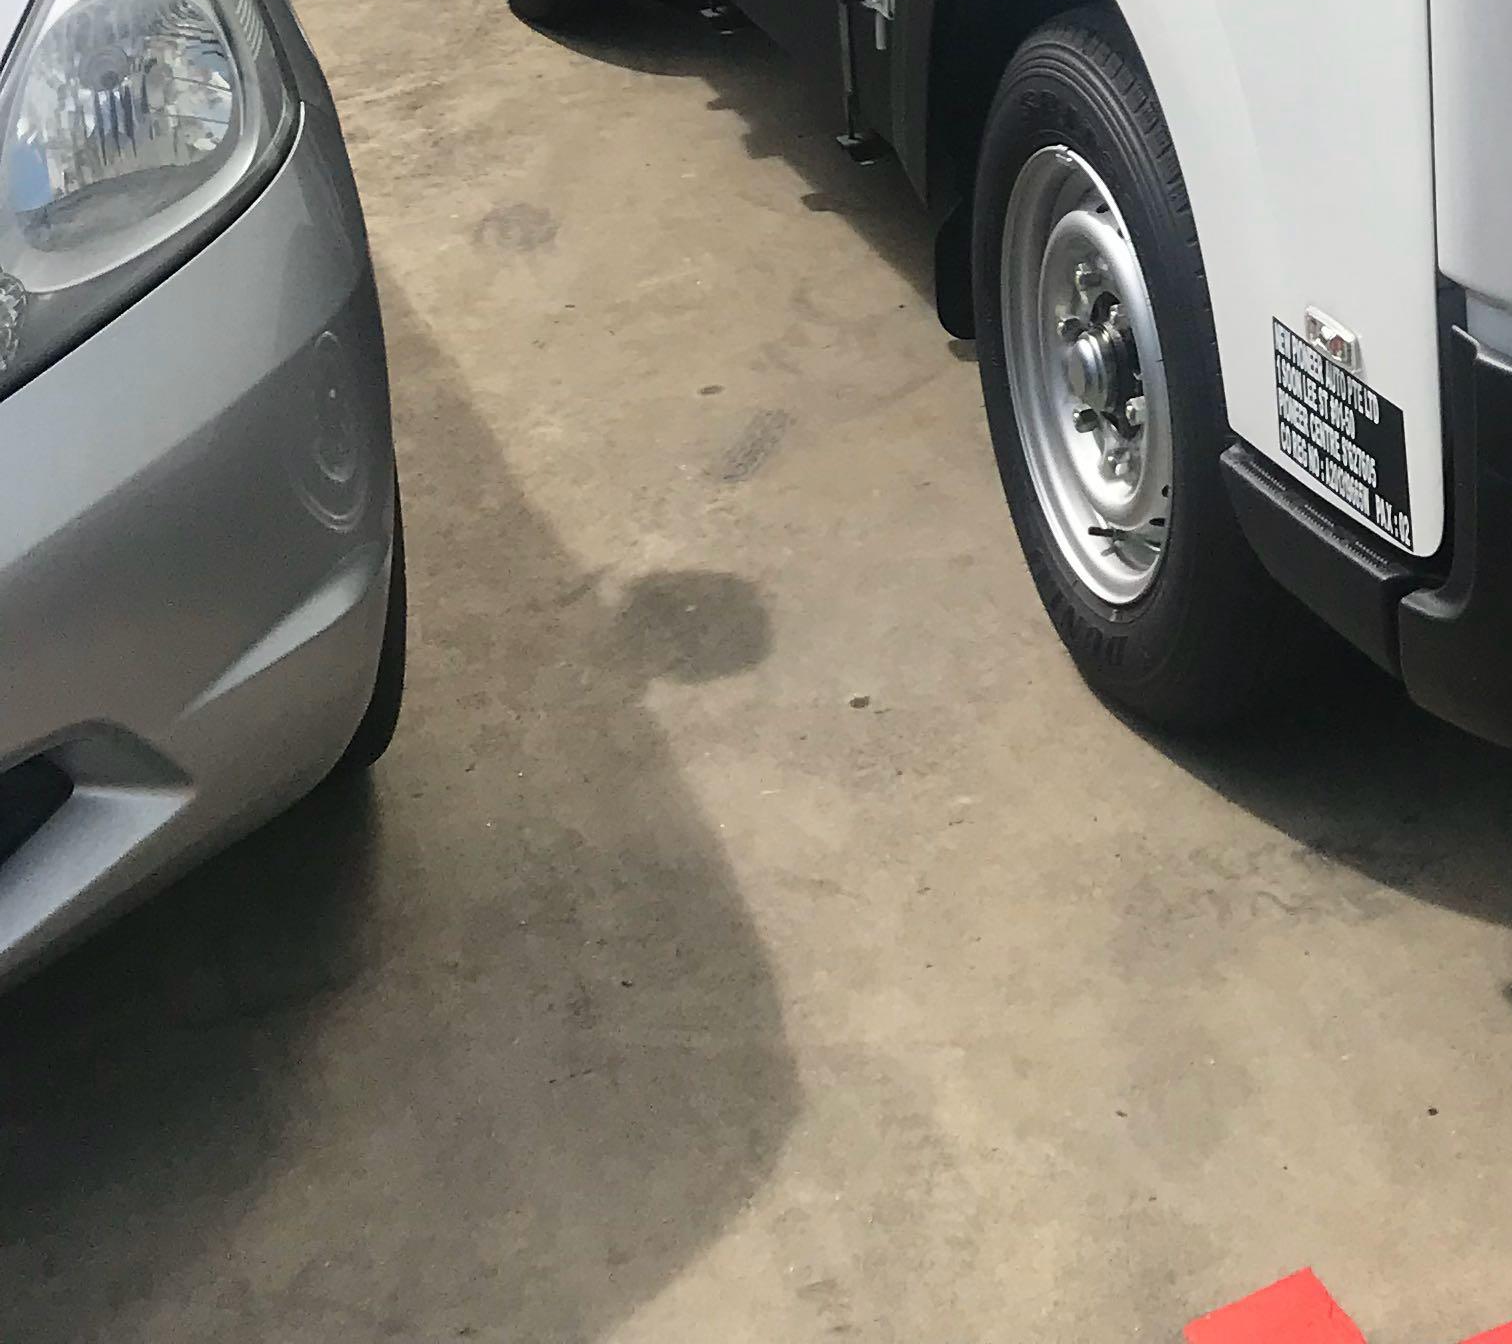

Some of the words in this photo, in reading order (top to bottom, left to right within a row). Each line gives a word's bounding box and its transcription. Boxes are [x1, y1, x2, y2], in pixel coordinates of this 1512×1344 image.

[1281, 358, 1302, 400] SOON
[1302, 374, 1317, 412] LEE
[1318, 386, 1329, 421] ST
[1291, 335, 1323, 384] PIONEER
[1324, 359, 1346, 401] AUTO
[1346, 375, 1364, 414] PTE
[1363, 387, 1380, 425] LTD
[1278, 388, 1309, 438] PIONEER
[1309, 411, 1340, 461] CENTRE
[1280, 421, 1291, 456] CO
[1292, 430, 1307, 468] REG
[1307, 442, 1319, 477] NO
[1375, 493, 1394, 535] PAX
[1398, 511, 1410, 547] 02
